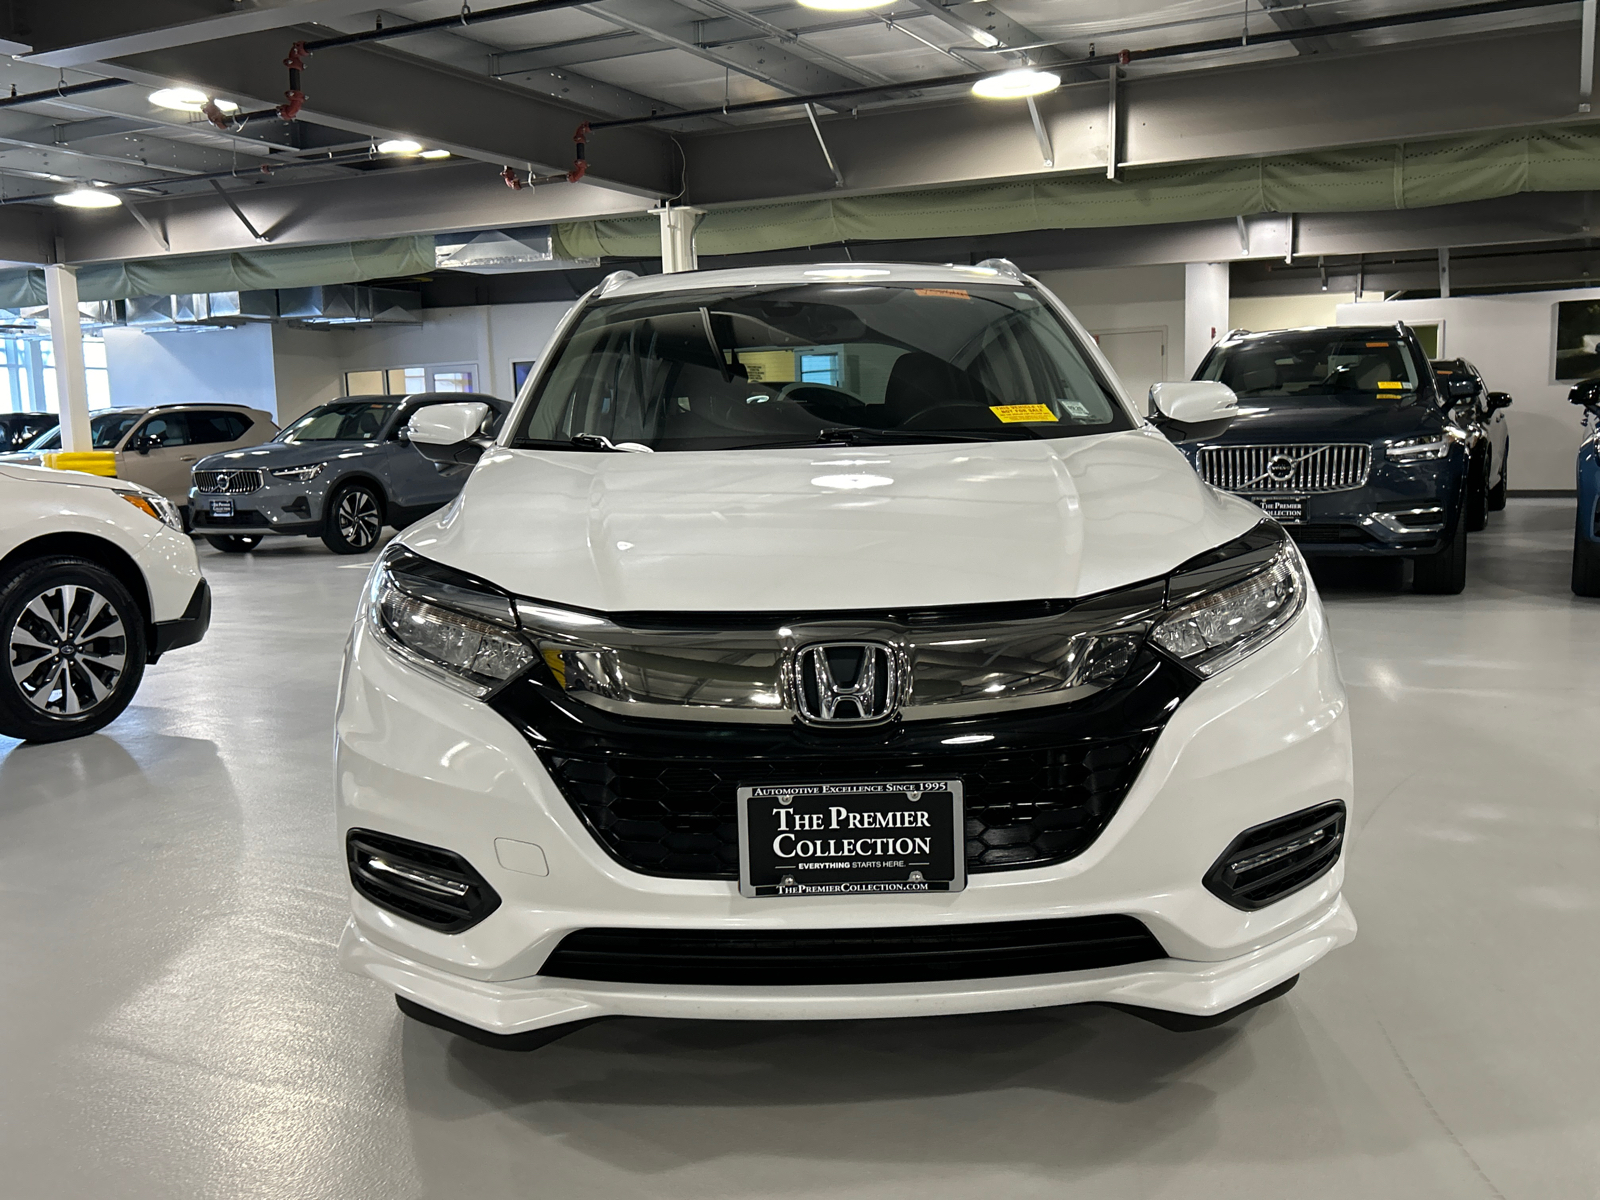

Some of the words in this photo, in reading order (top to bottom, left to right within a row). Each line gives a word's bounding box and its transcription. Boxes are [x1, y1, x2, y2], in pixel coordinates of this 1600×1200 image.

[754, 787, 820, 796] AUTOMOTIVE
[822, 785, 884, 793] EXCELLENCE
[885, 783, 916, 792] SINCE
[919, 782, 946, 791] 1995
[772, 807, 825, 831] THE
[828, 806, 931, 830] PREMIER
[772, 833, 931, 858] COLLECTION
[798, 862, 851, 870] EVERYTHING
[852, 861, 882, 869] STARTS
[883, 860, 906, 868] HERE.
[776, 882, 929, 895] THEPREMIERCOLLECTION.COM
